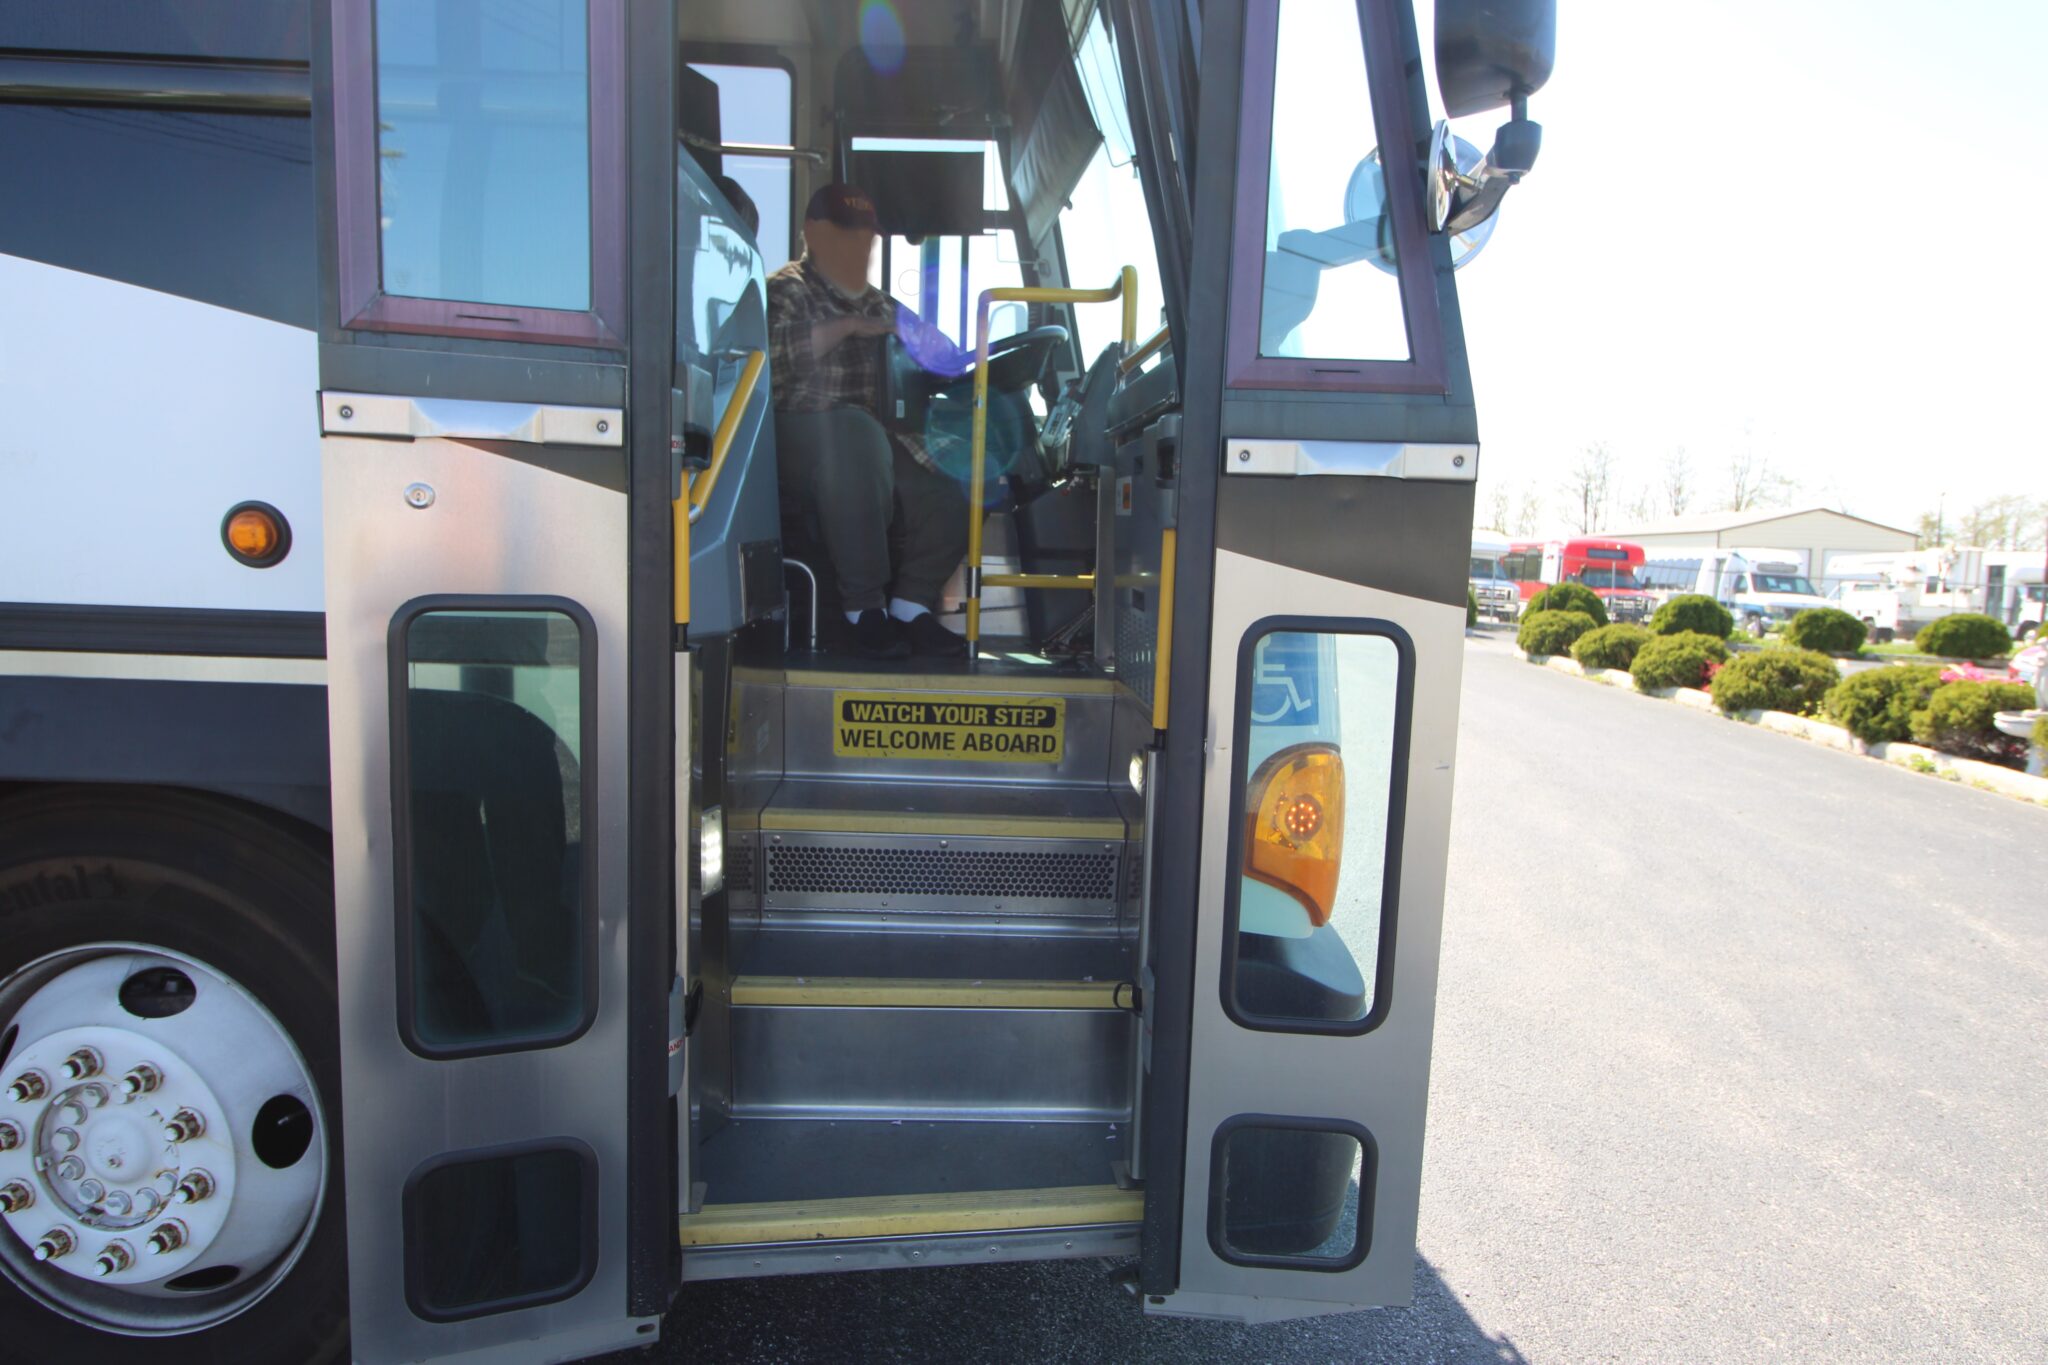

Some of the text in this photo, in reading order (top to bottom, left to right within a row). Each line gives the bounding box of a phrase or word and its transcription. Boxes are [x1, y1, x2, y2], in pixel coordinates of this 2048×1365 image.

[851, 703, 1047, 726] WATCH YOUR STEP
[840, 728, 1057, 753] WELCOME ABOARD
